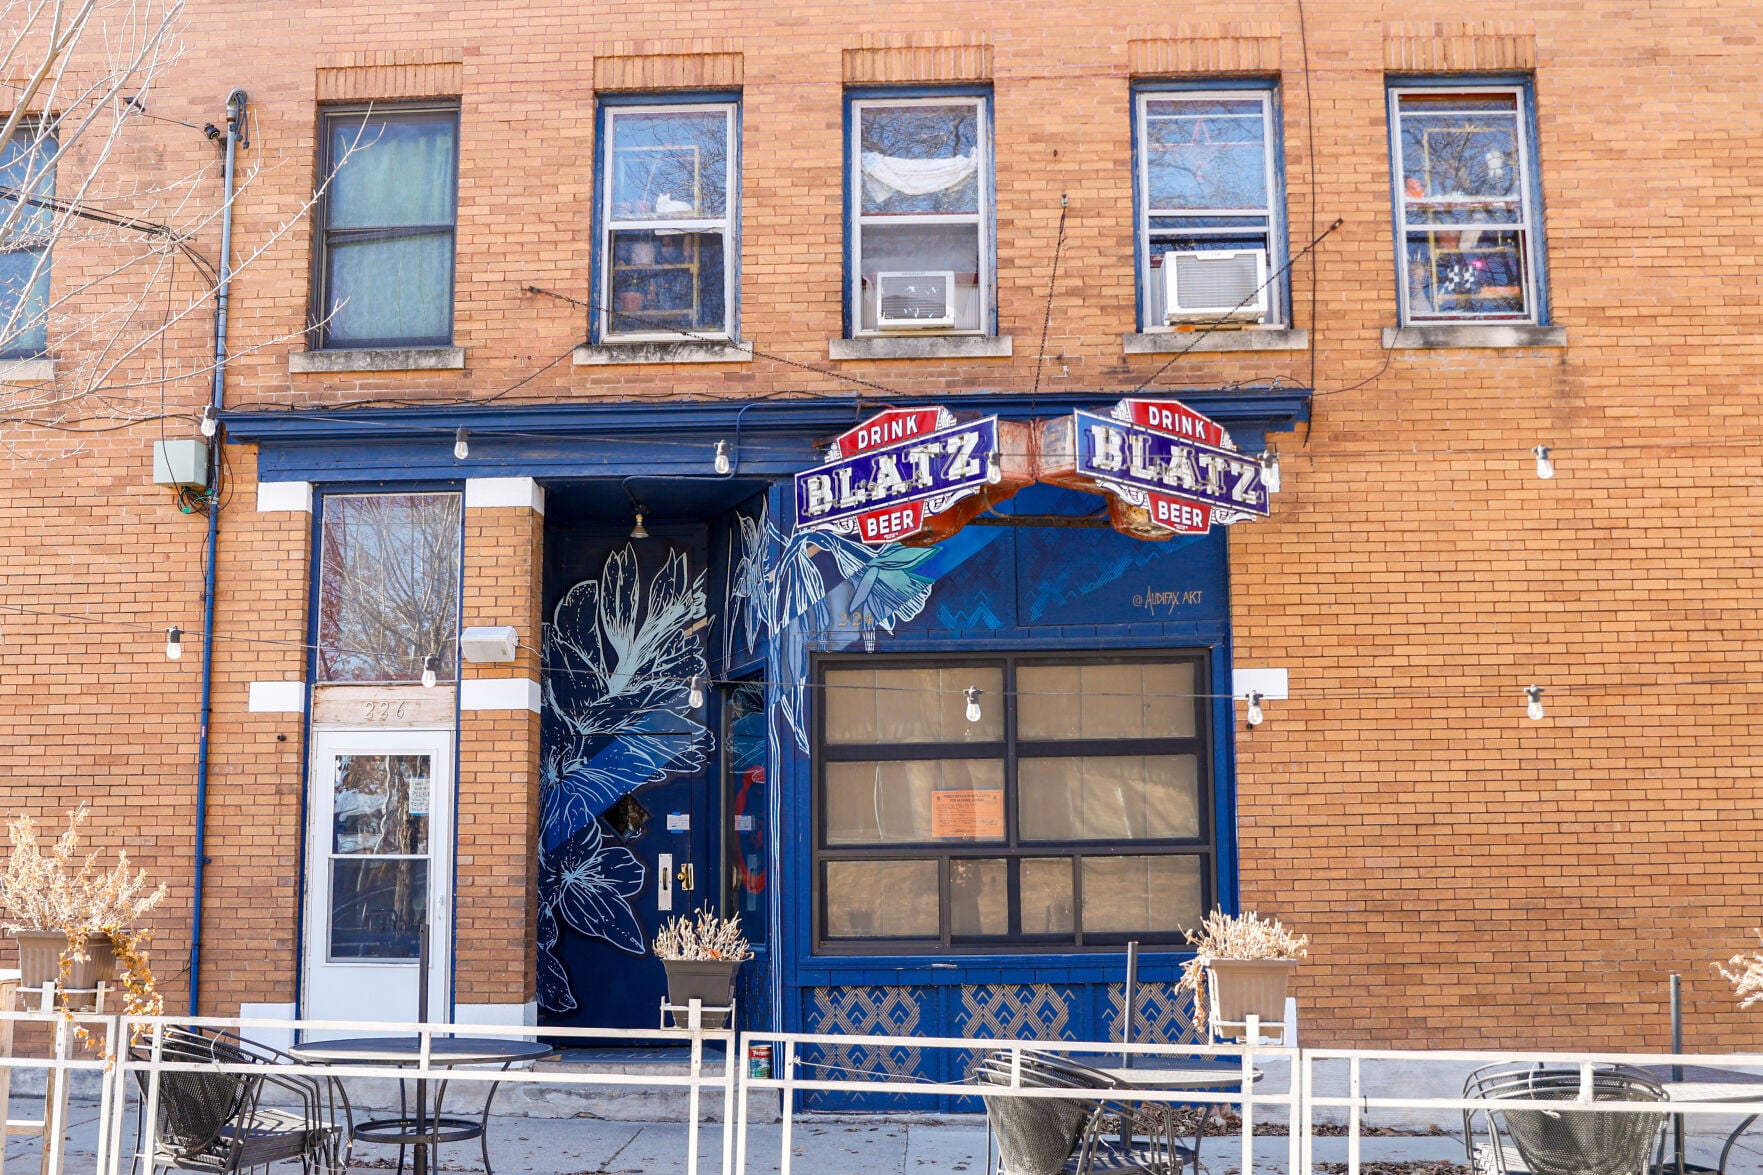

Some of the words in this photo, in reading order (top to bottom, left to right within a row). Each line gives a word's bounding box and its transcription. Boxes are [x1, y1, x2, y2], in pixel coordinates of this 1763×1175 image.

[857, 414, 919, 450] DRINK
[1148, 405, 1206, 440] DRINK
[802, 431, 981, 517] BLATZ
[1090, 424, 1260, 506] BLATZ
[867, 509, 914, 537] BEER
[1157, 500, 1203, 528] BEER
[837, 611, 874, 627] 224
[363, 701, 406, 720] 226
